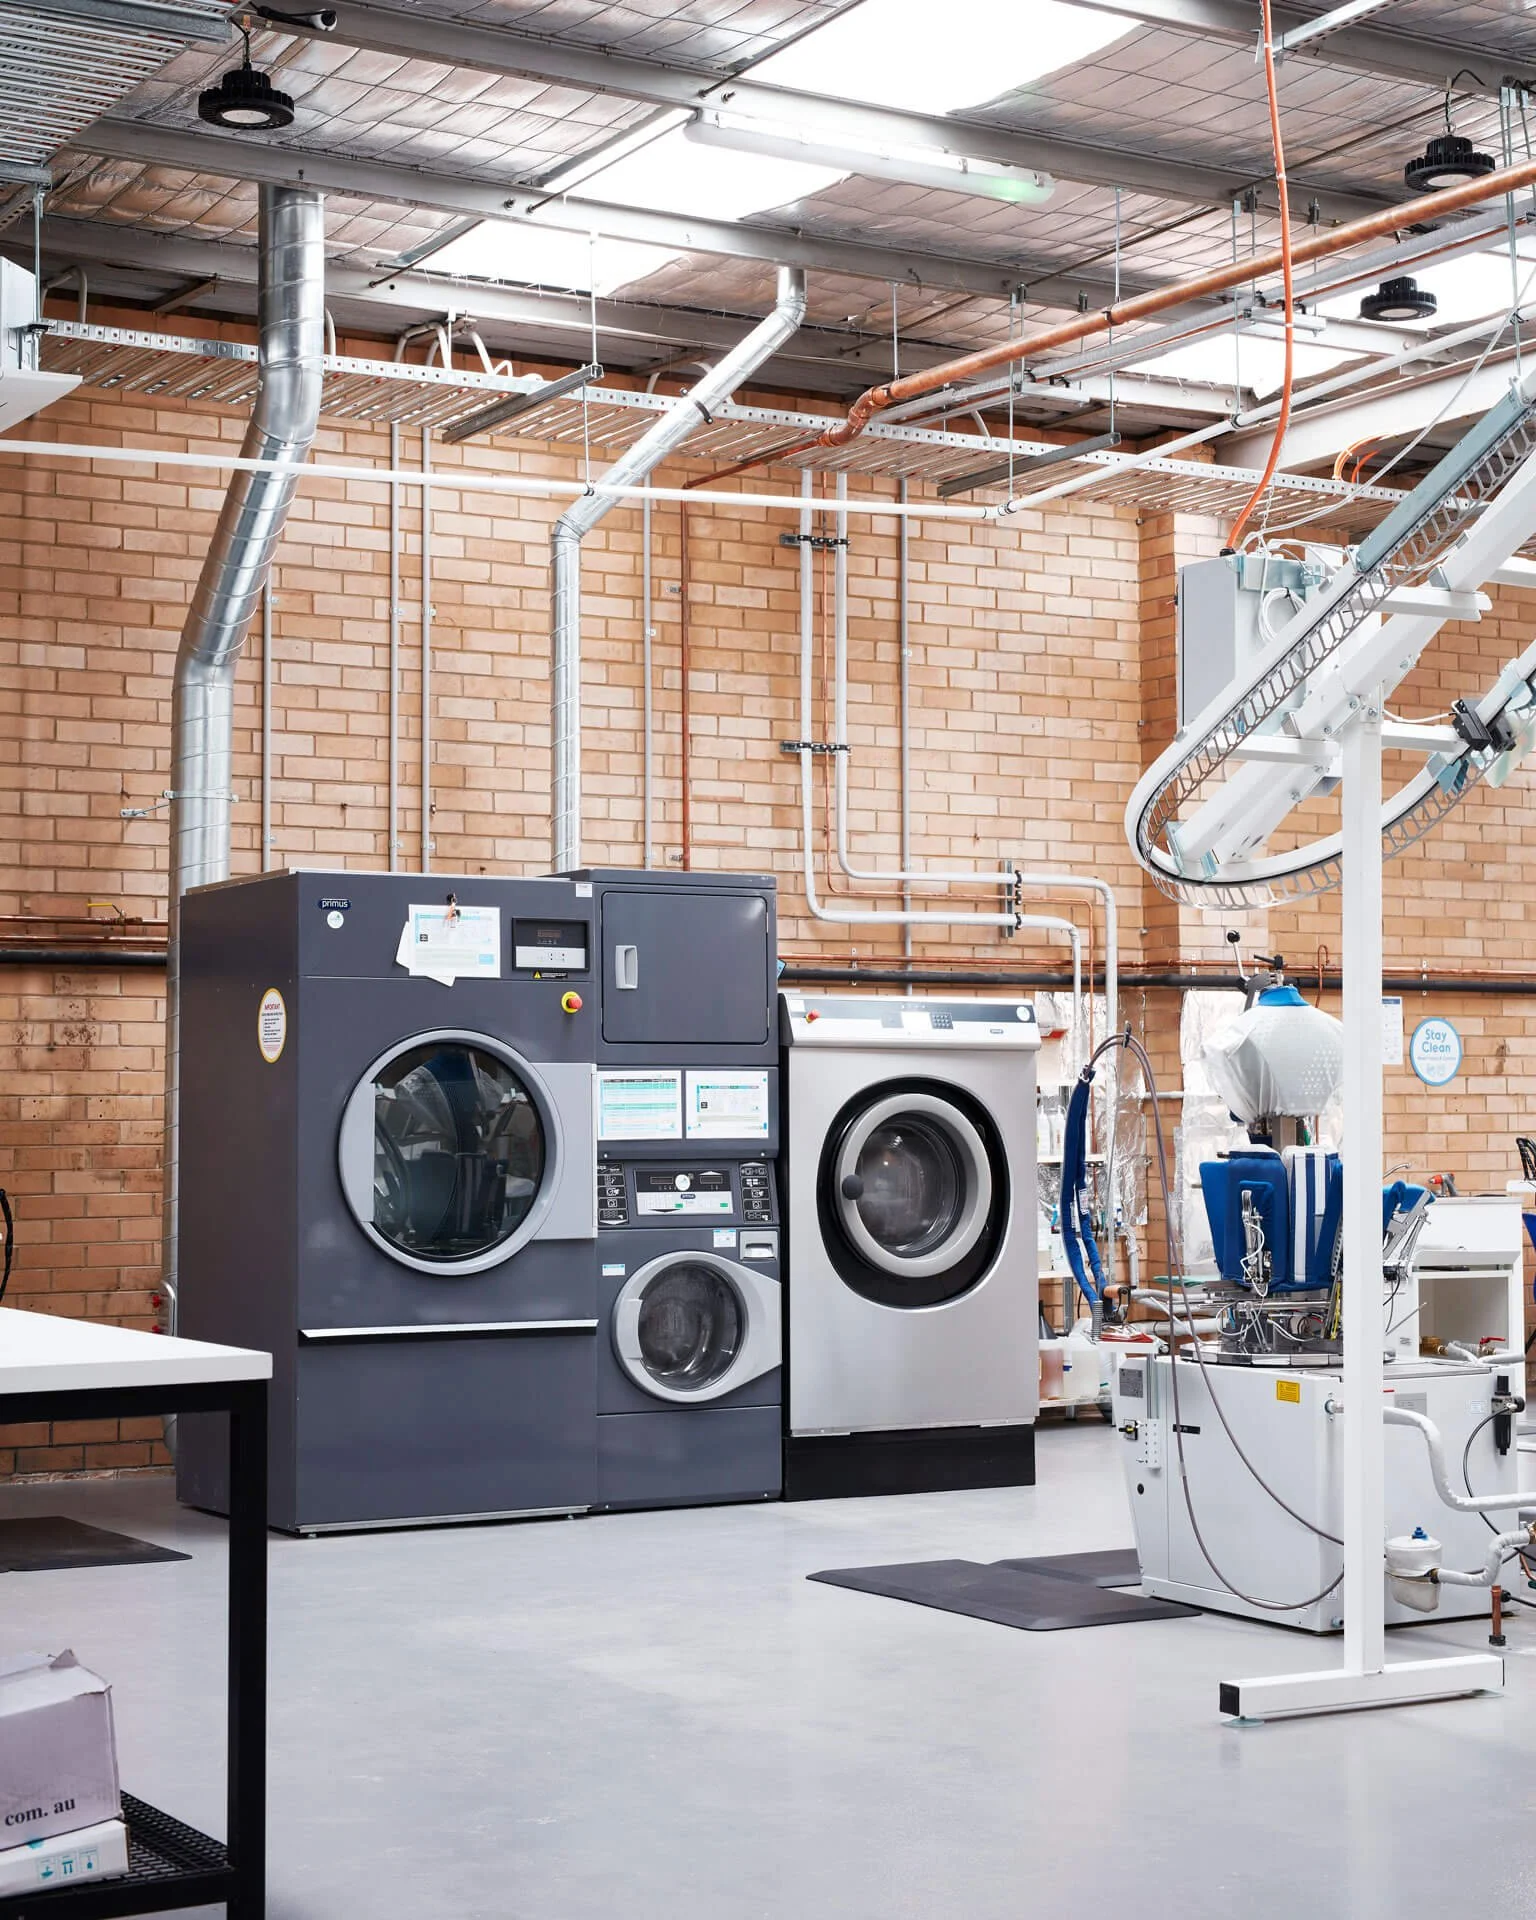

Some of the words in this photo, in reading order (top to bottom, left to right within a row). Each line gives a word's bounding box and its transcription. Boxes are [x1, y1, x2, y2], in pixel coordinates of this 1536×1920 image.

[322, 900, 348, 908] primus
[1425, 1028, 1447, 1042] Stay
[1421, 1041, 1451, 1053] Clean
[4, 1807, 48, 1826] com.
[53, 1798, 76, 1814] au
